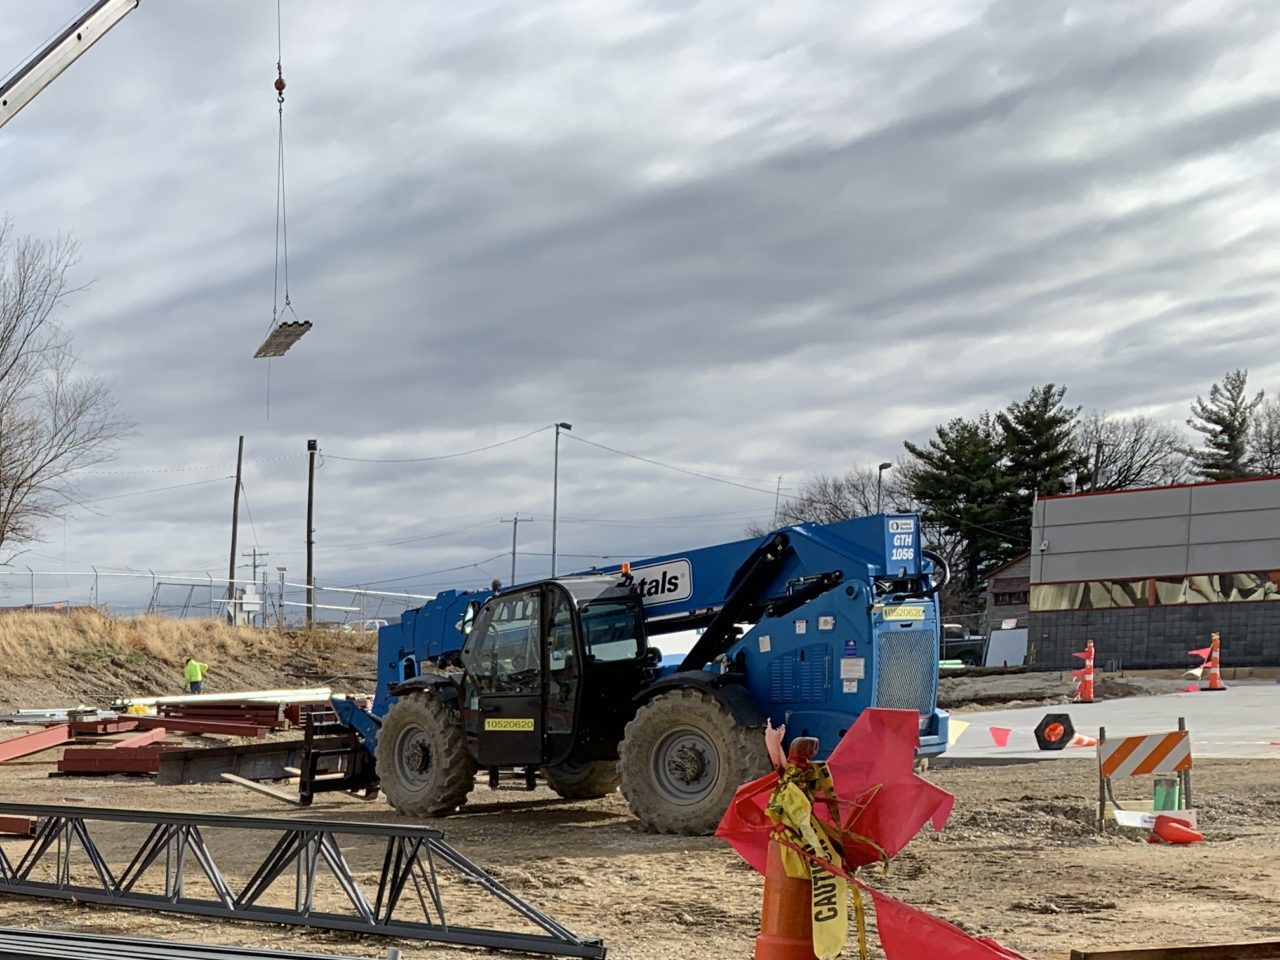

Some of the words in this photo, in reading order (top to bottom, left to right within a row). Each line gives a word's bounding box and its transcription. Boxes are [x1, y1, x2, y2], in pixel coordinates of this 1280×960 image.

[893, 534, 913, 546] GTH
[891, 548, 914, 560] 1056
[637, 571, 679, 597] tals
[486, 720, 533, 729] 10520620
